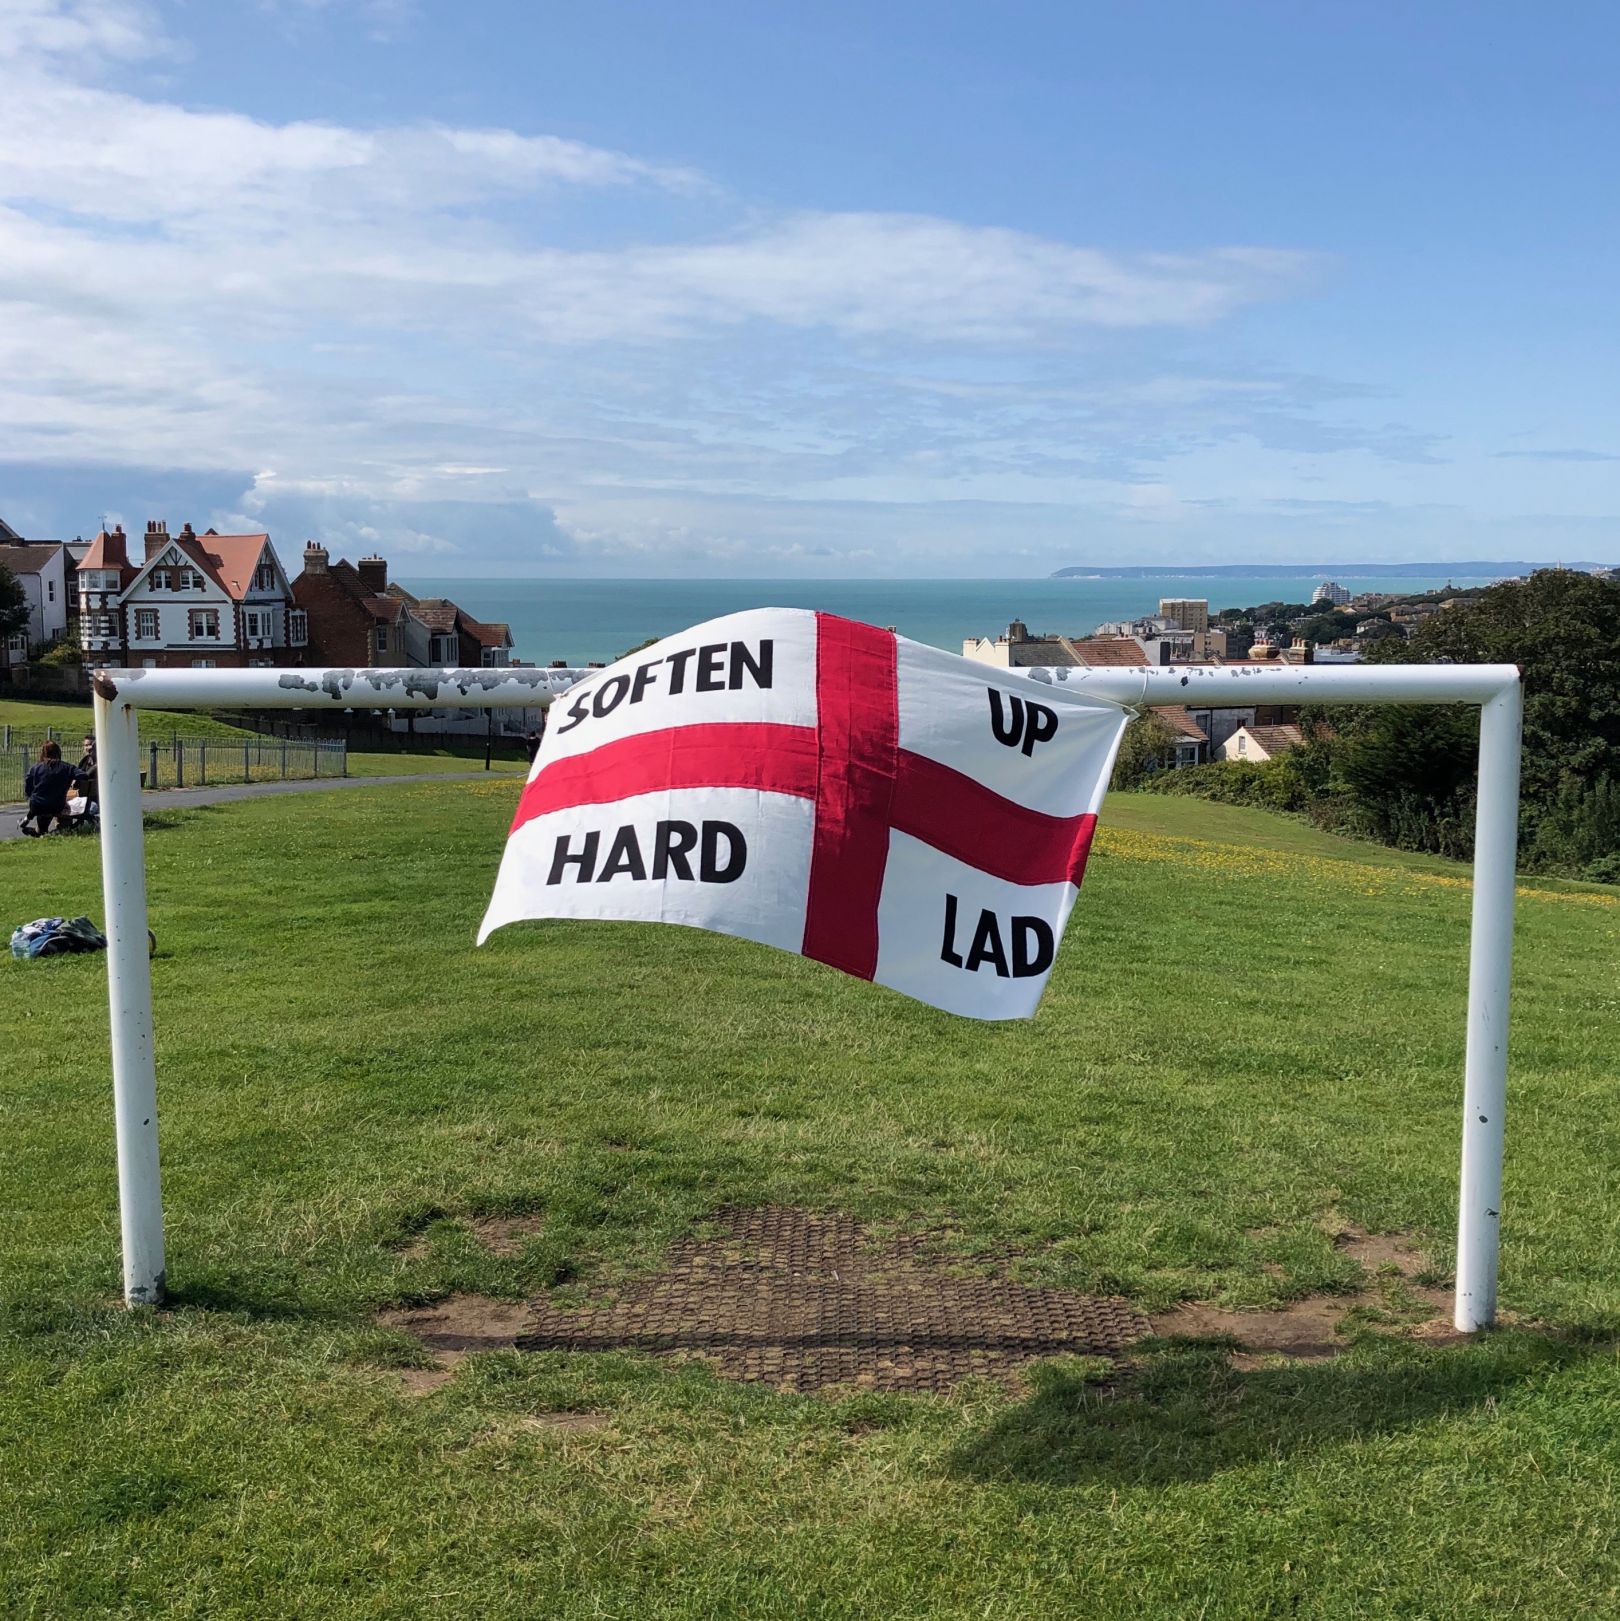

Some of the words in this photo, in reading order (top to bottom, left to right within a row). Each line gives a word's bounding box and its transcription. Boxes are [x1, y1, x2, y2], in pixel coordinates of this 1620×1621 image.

[557, 639, 774, 735] SOFTEN
[987, 687, 1059, 758] UP
[546, 820, 747, 885] HARD
[940, 893, 1055, 979] LAD
